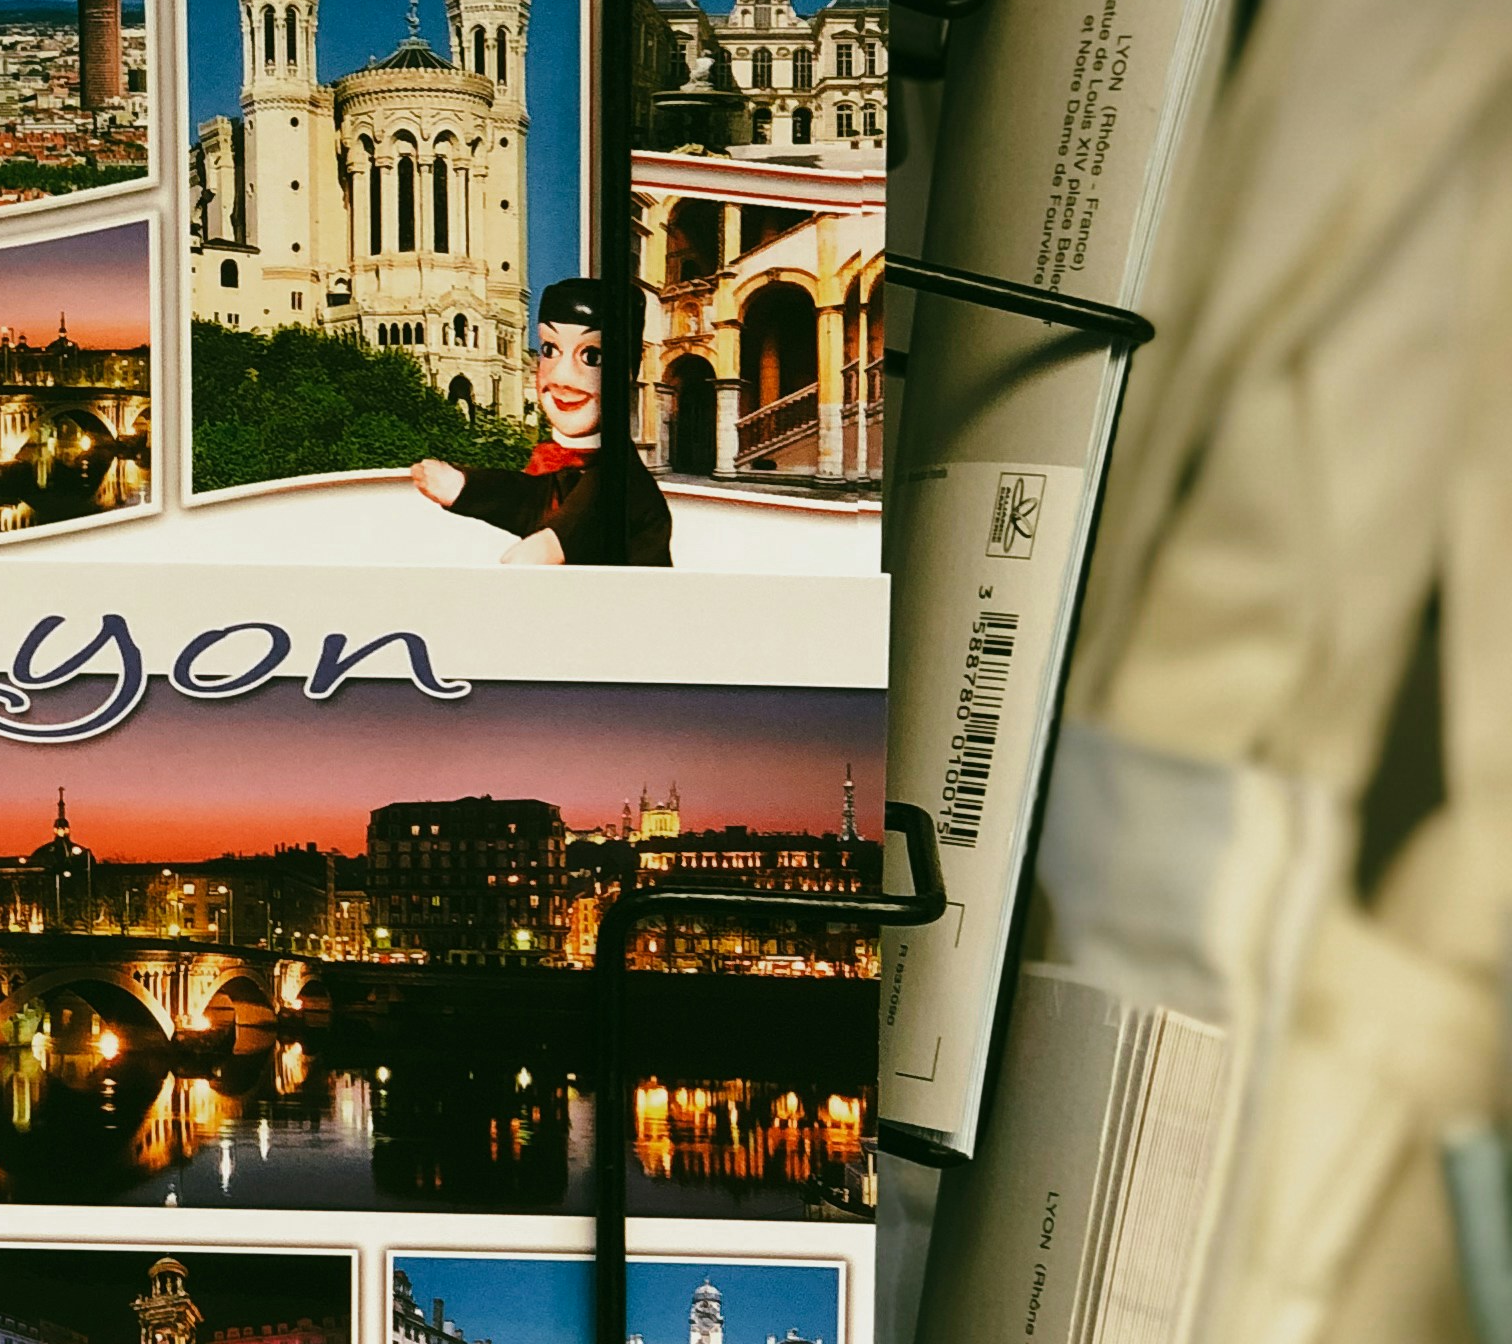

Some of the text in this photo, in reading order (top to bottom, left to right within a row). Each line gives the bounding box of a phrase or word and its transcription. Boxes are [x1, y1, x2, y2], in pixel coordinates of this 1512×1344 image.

[1092, 47, 1108, 72] de
[1108, 34, 1132, 92] LYON
[1080, 79, 1102, 130] Louis
[1033, 15, 1096, 285] et Notre Dame de Fourvière
[1073, 137, 1092, 172] XIV
[1090, 106, 1117, 176] (Rhône
[1060, 178, 1082, 230] place
[1069, 198, 1099, 271] France)
[936, 584, 993, 836] 3 588780 010015
[1039, 1191, 1060, 1251] LYON
[1024, 1262, 1047, 1337] (Rhône
